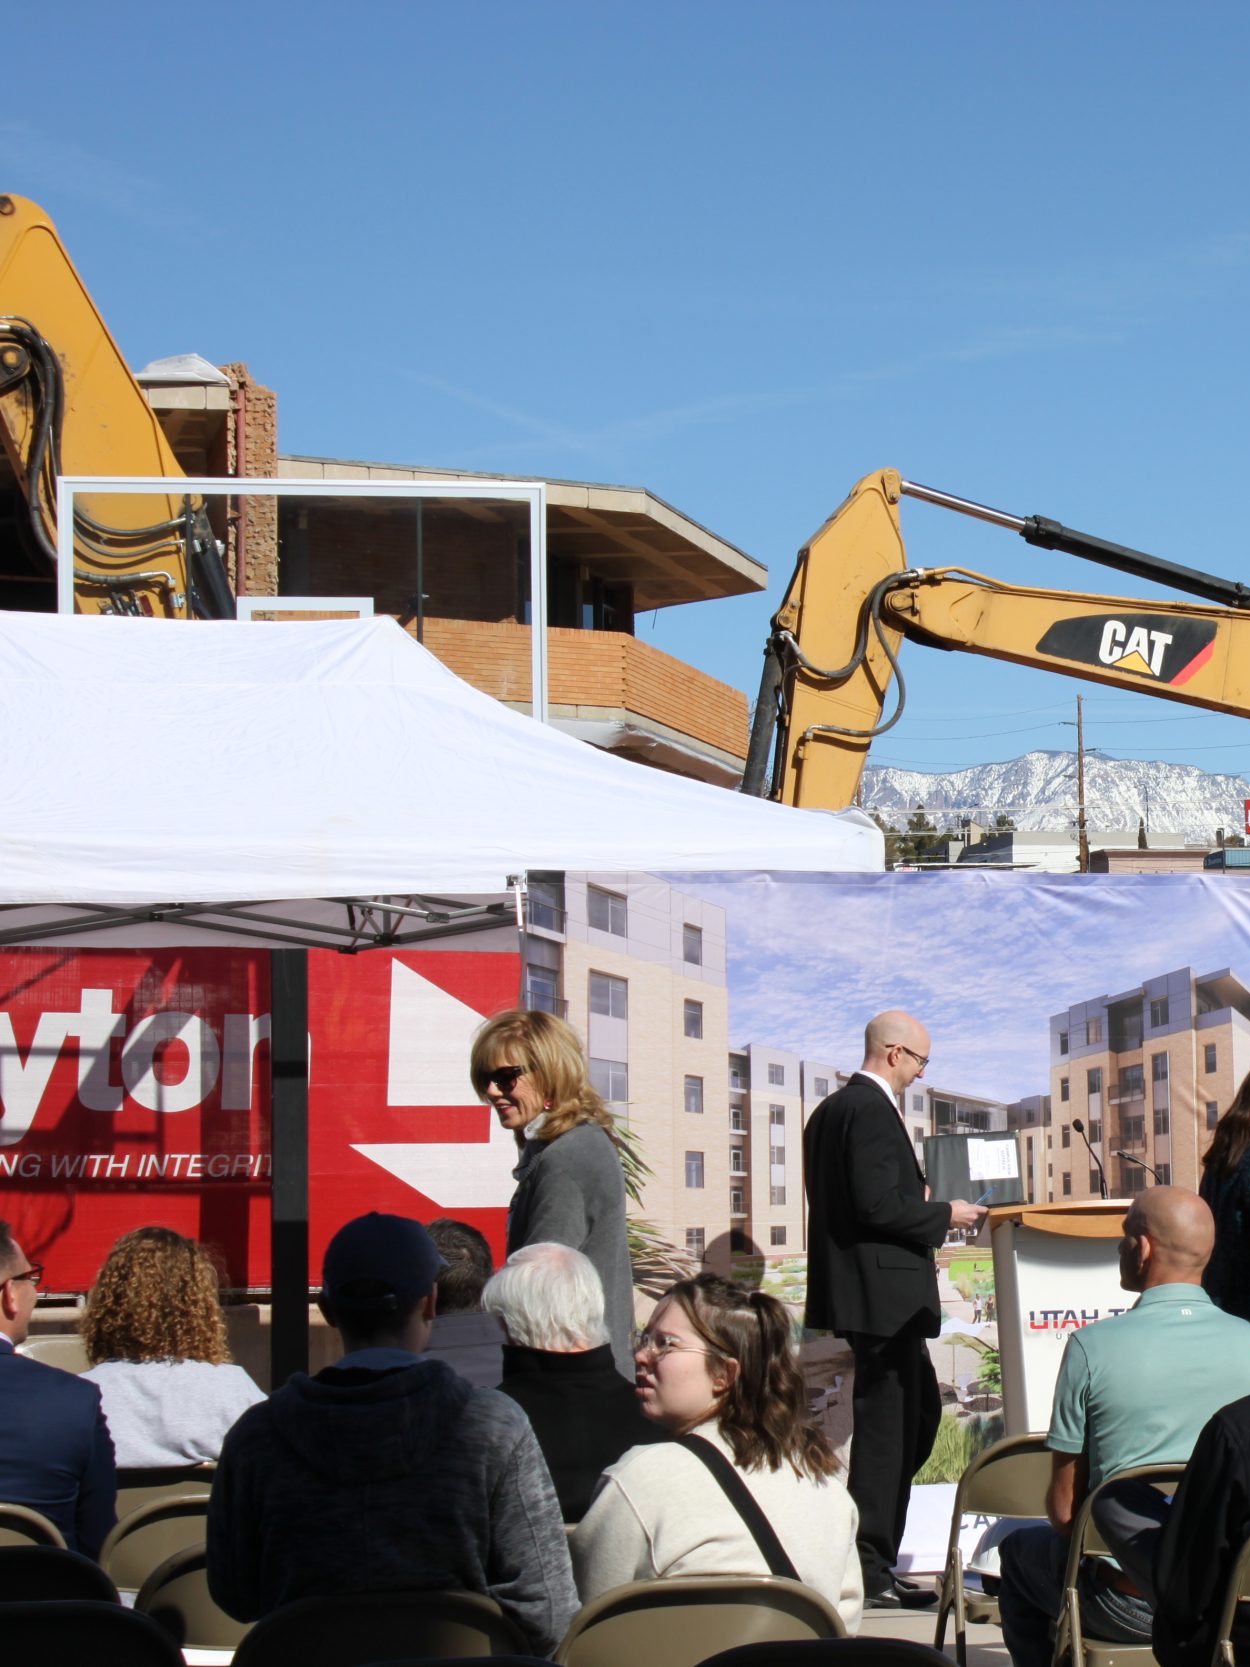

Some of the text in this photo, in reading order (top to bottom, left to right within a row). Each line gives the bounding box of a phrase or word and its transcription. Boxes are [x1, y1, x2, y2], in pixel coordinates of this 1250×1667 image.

[1099, 620, 1173, 676] CAT
[51, 1153, 131, 1178] WITH
[1029, 1309, 1099, 1330] UTAH
